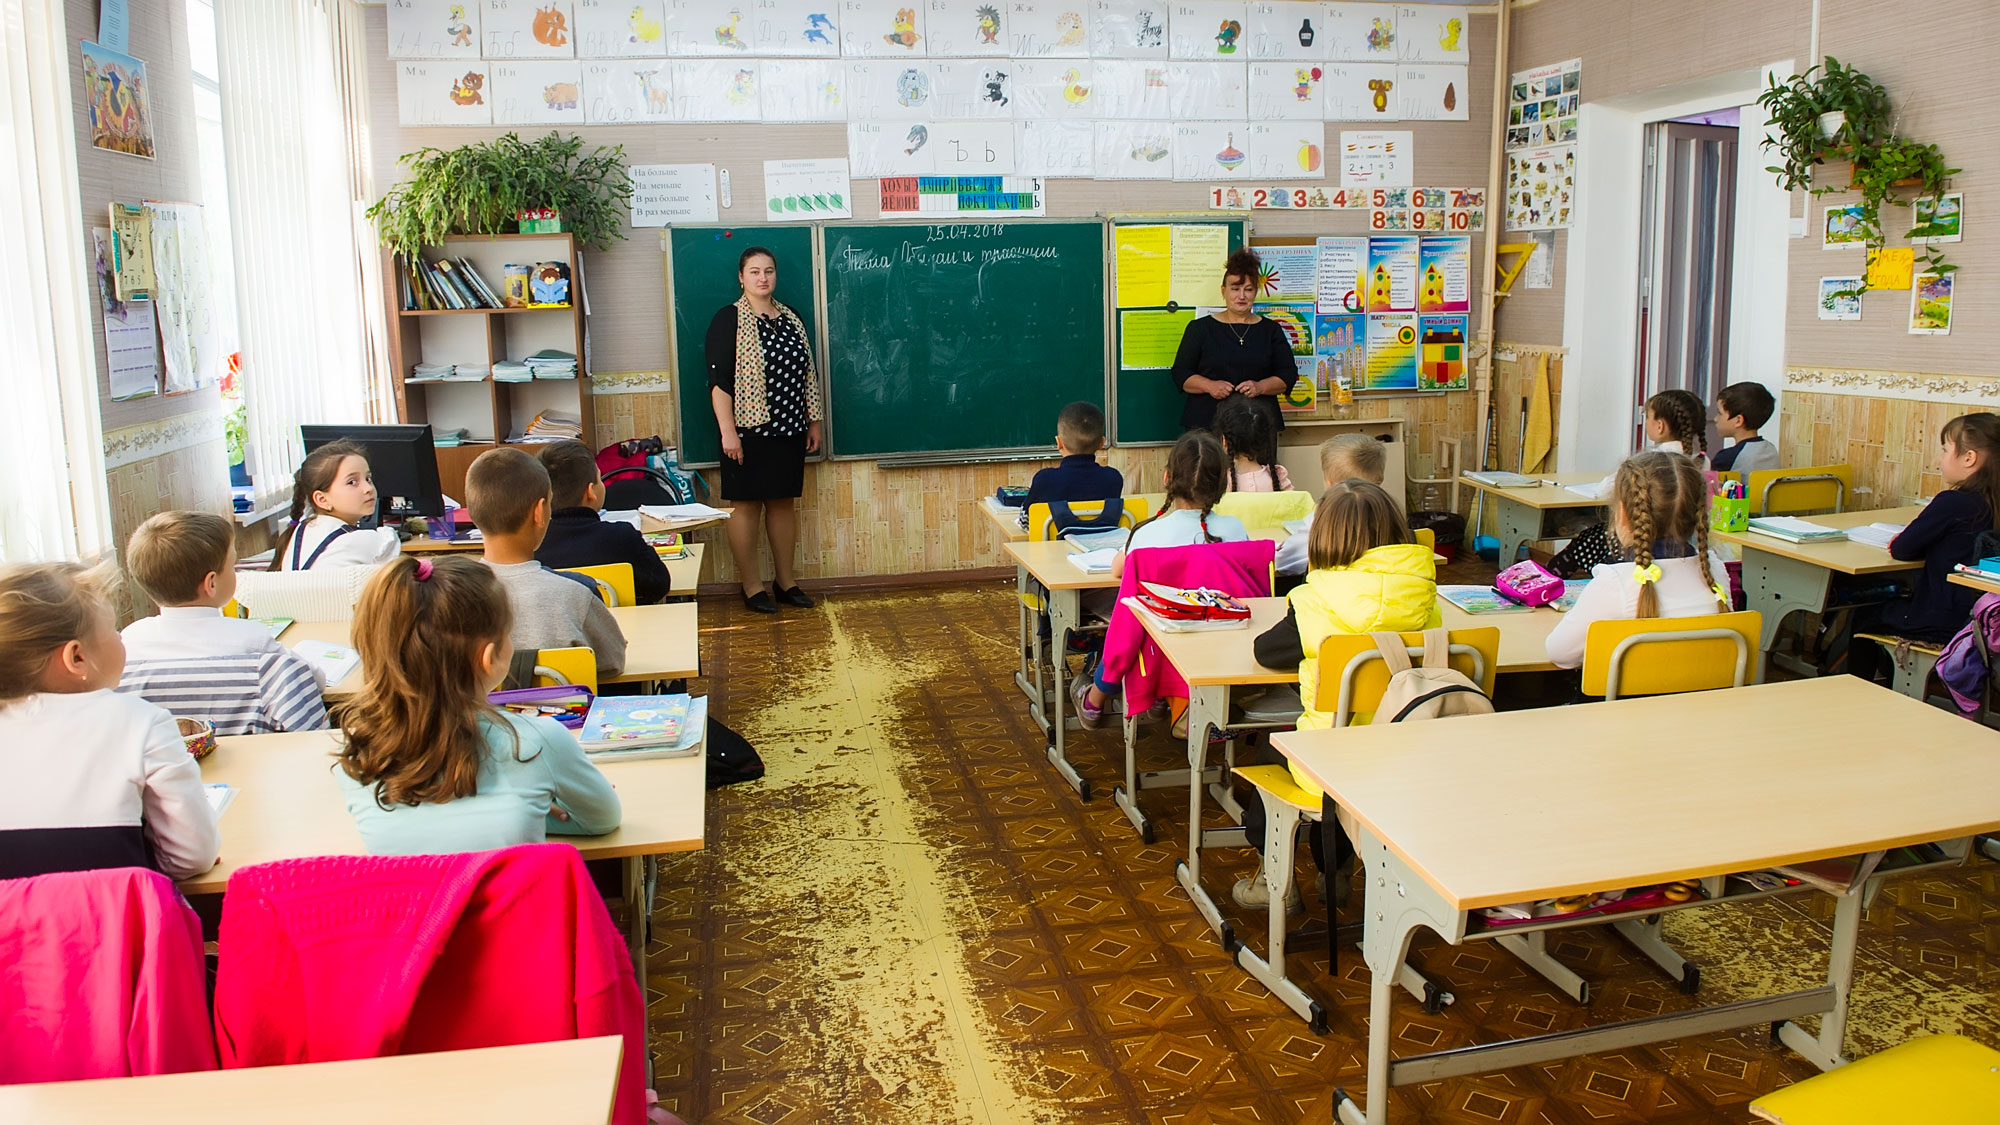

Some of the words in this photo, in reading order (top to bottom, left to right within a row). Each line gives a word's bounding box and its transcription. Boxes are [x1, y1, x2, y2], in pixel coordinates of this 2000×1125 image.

[948, 139, 969, 162] Ъ
[647, 168, 678, 176] больше
[1349, 163, 1356, 172] 2
[645, 197, 658, 205] раз
[659, 194, 690, 202] больше
[1212, 189, 1222, 207] 1
[1253, 189, 1268, 207] 2
[1293, 189, 1307, 207] 3
[1333, 189, 1347, 208] 4
[1373, 189, 1386, 207] 5
[1412, 189, 1425, 207] 6
[1450, 190, 1462, 207] 7
[1372, 211, 1386, 229] 8
[1412, 211, 1425, 229] 9
[1448, 212, 1469, 229] 10
[926, 223, 1004, 242] 25.04.2018
[1875, 274, 1900, 287] ГОДА
